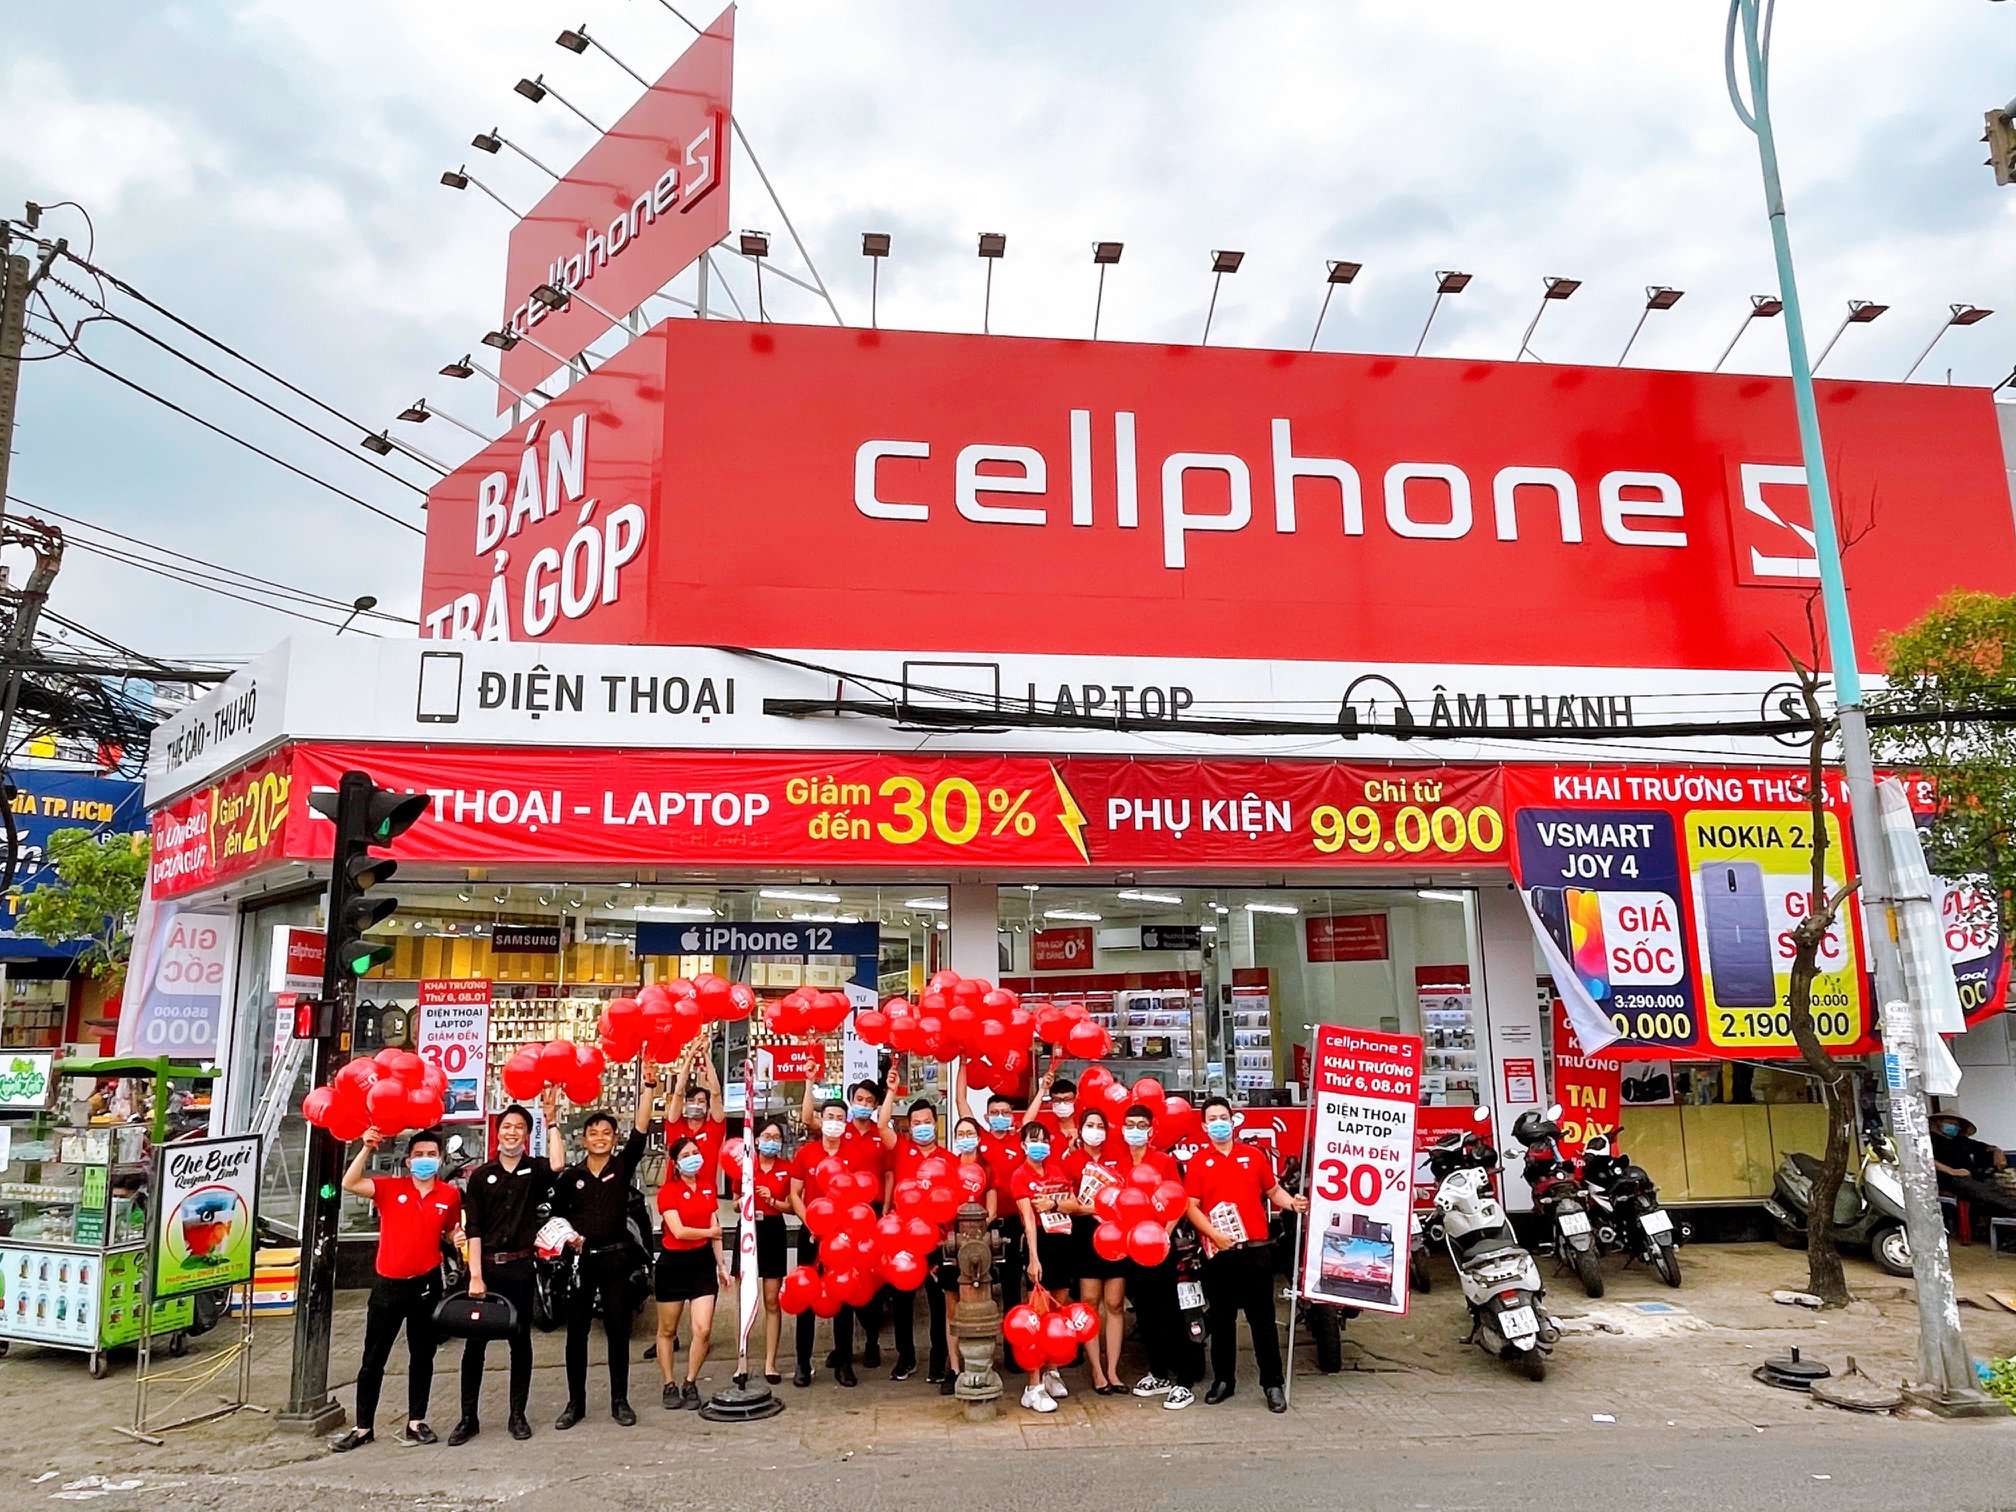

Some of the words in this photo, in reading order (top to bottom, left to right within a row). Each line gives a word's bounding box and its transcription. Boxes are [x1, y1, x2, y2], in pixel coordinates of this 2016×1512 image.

[475, 412, 590, 557] BÁN
[522, 498, 647, 638] GÓP
[477, 664, 584, 720] ĐIỆN
[600, 676, 735, 723] THOẠI
[1027, 682, 1194, 722] LAPTOP
[1429, 684, 1488, 728] ÂM
[185, 718, 205, 759] CÀO
[214, 700, 236, 745] THU
[238, 679, 258, 734] HỘ
[785, 774, 871, 805] Giảm
[1363, 777, 1408, 804] Chỉ
[1412, 779, 1445, 802] từ
[1552, 775, 1621, 801] KHAI
[1623, 774, 1744, 803] TRƯƠNG
[1746, 774, 1808, 803] THỨ
[41, 796, 68, 818] TP.
[71, 800, 114, 823] HCM
[425, 788, 563, 833] THOẠI
[602, 790, 771, 827] LAPTOP
[877, 776, 1037, 846] 30%
[1107, 797, 1191, 840] PHỤ
[1202, 792, 1293, 840] KIỆN
[807, 808, 871, 841] đến
[1309, 804, 1505, 854] 99.000
[1536, 822, 1655, 850] VSMART
[1697, 825, 1785, 850] NOKIA
[1790, 825, 1831, 850] 2.
[1561, 854, 1615, 880] JOY
[1620, 853, 1640, 879] 4
[1617, 898, 1672, 932] GIÁ
[495, 934, 558, 946] SAMSUNG
[704, 928, 798, 951] iPhone
[804, 928, 834, 951] 12
[1777, 932, 1840, 959] SC
[1612, 937, 1677, 974] SỐC
[424, 982, 448, 991] KHAI
[449, 981, 487, 990] TRƯƠNG
[425, 993, 445, 1002] Thứ
[458, 993, 486, 1002] 08.01
[426, 1006, 451, 1019] ĐIỆN
[452, 1008, 483, 1019] THOẠI
[434, 1020, 474, 1029] LAPTOP
[1612, 1012, 1691, 1040] 0.000
[1719, 1012, 1850, 1039] 2.19000
[427, 1031, 455, 1041] GIẢM
[456, 1030, 479, 1041] ĐẾN
[1325, 1035, 1398, 1055] cellphone
[422, 1044, 484, 1073] 30%
[776, 1064, 794, 1073] TỐT
[1323, 1055, 1357, 1071] KHAI
[1358, 1059, 1414, 1078] TRƯƠNG
[1324, 1071, 1354, 1088] Thứ
[1356, 1076, 1370, 1093] 6,
[1371, 1079, 1412, 1095] 08.01
[1565, 1085, 1607, 1113] TẠI
[1325, 1102, 1359, 1121] ĐIỆN
[1362, 1107, 1407, 1126] THOẠI
[1337, 1120, 1393, 1139] LAPTOP
[1327, 1140, 1365, 1158] GIẢM
[1367, 1145, 1400, 1162] ĐẾN
[170, 1153, 204, 1178] Chè
[1316, 1158, 1407, 1207] 30%
